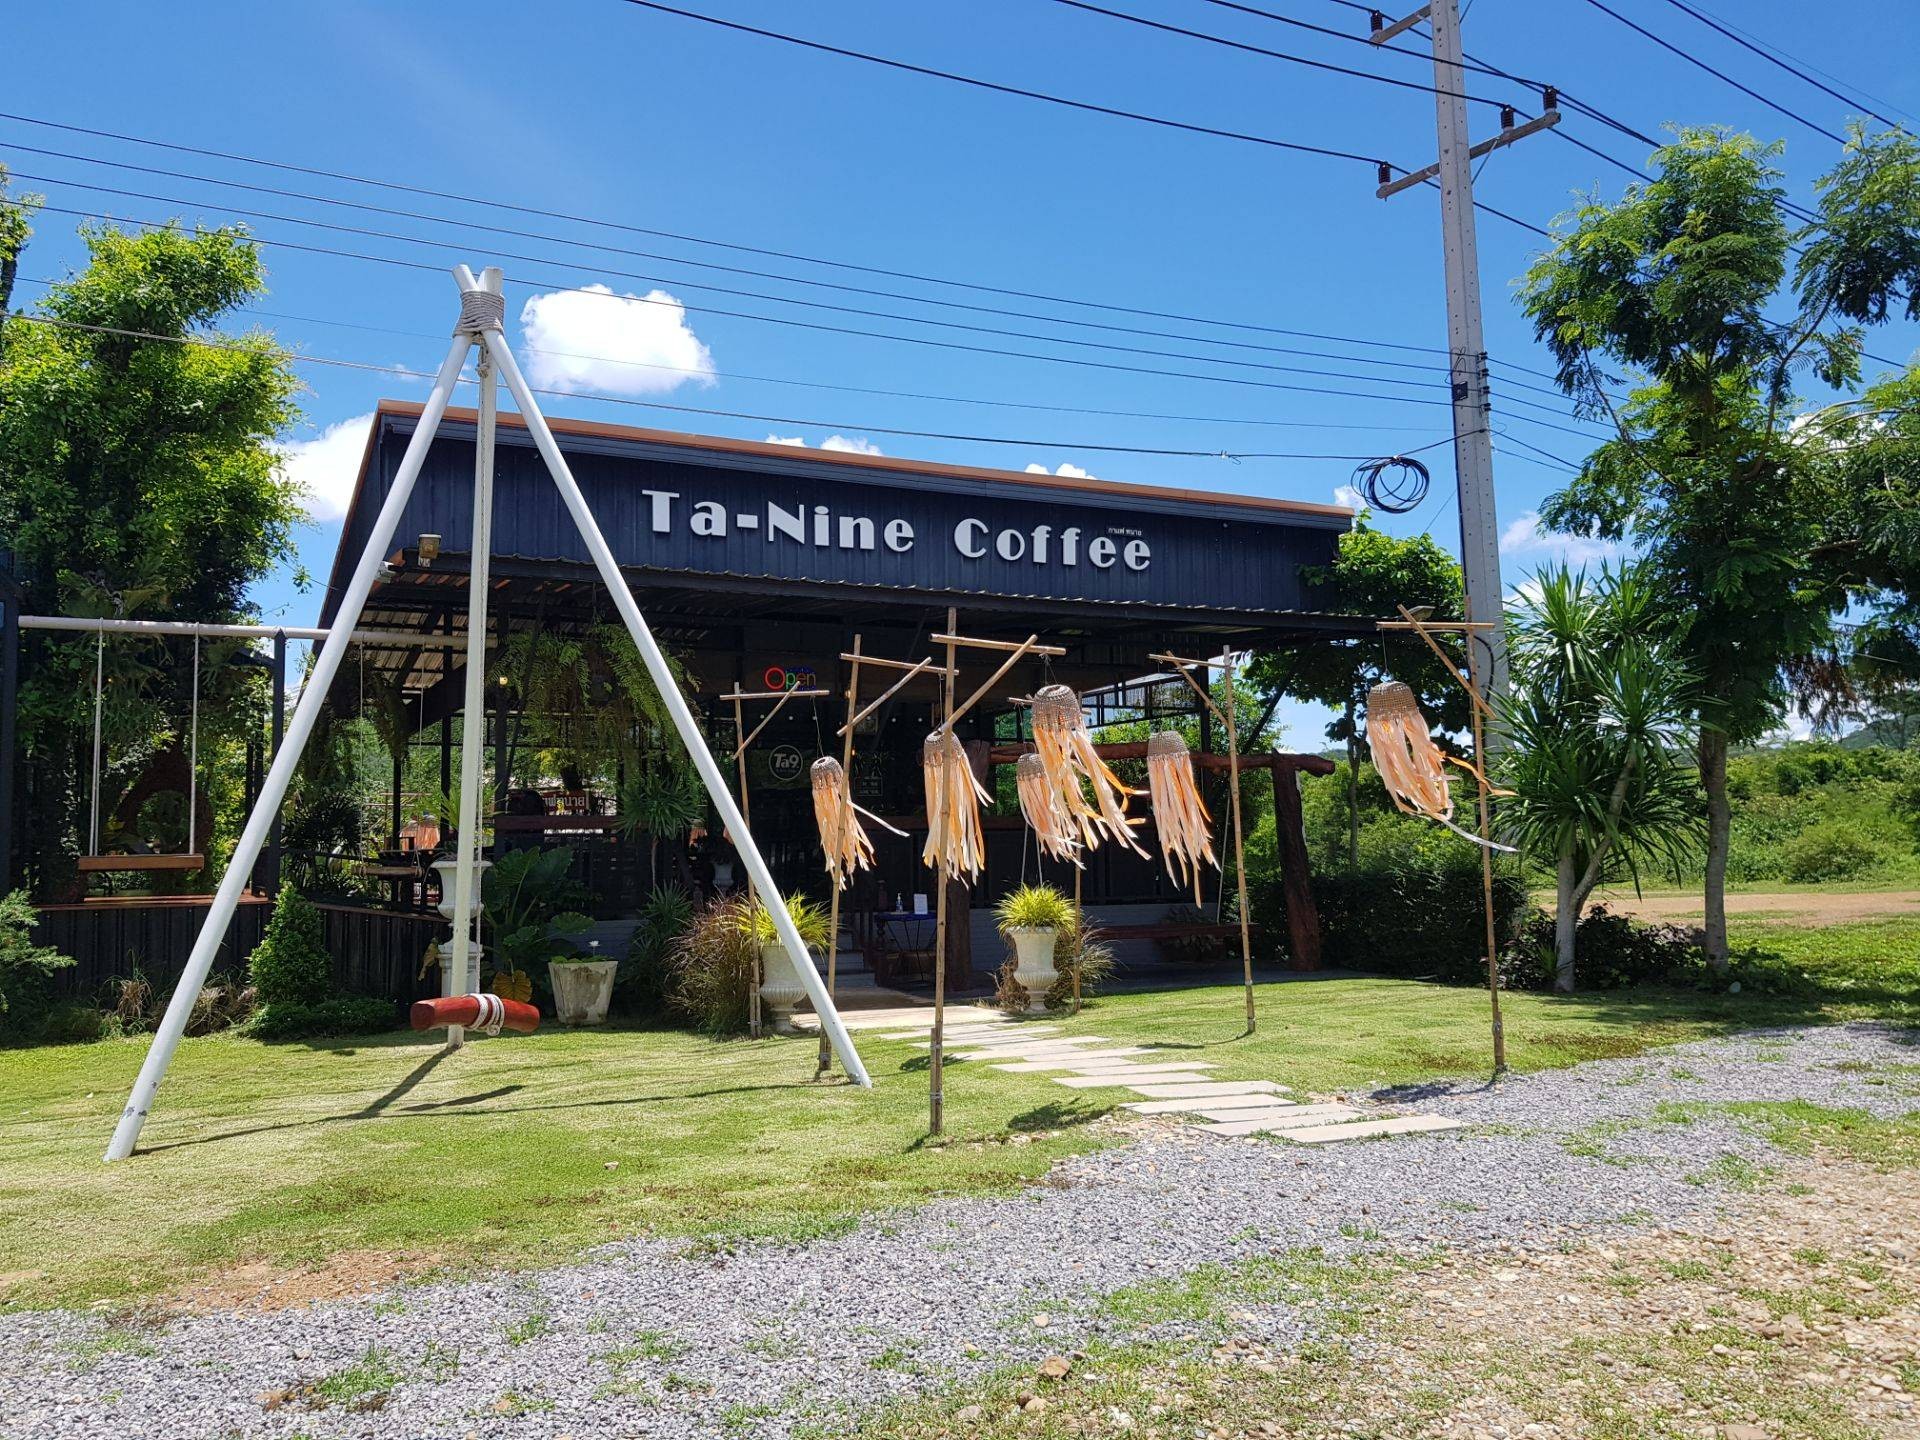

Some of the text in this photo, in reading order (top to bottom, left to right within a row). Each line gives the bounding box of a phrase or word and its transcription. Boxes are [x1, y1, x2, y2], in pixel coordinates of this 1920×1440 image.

[642, 489, 1152, 571] Ta-Nine Coffee
[765, 667, 816, 690] Open
